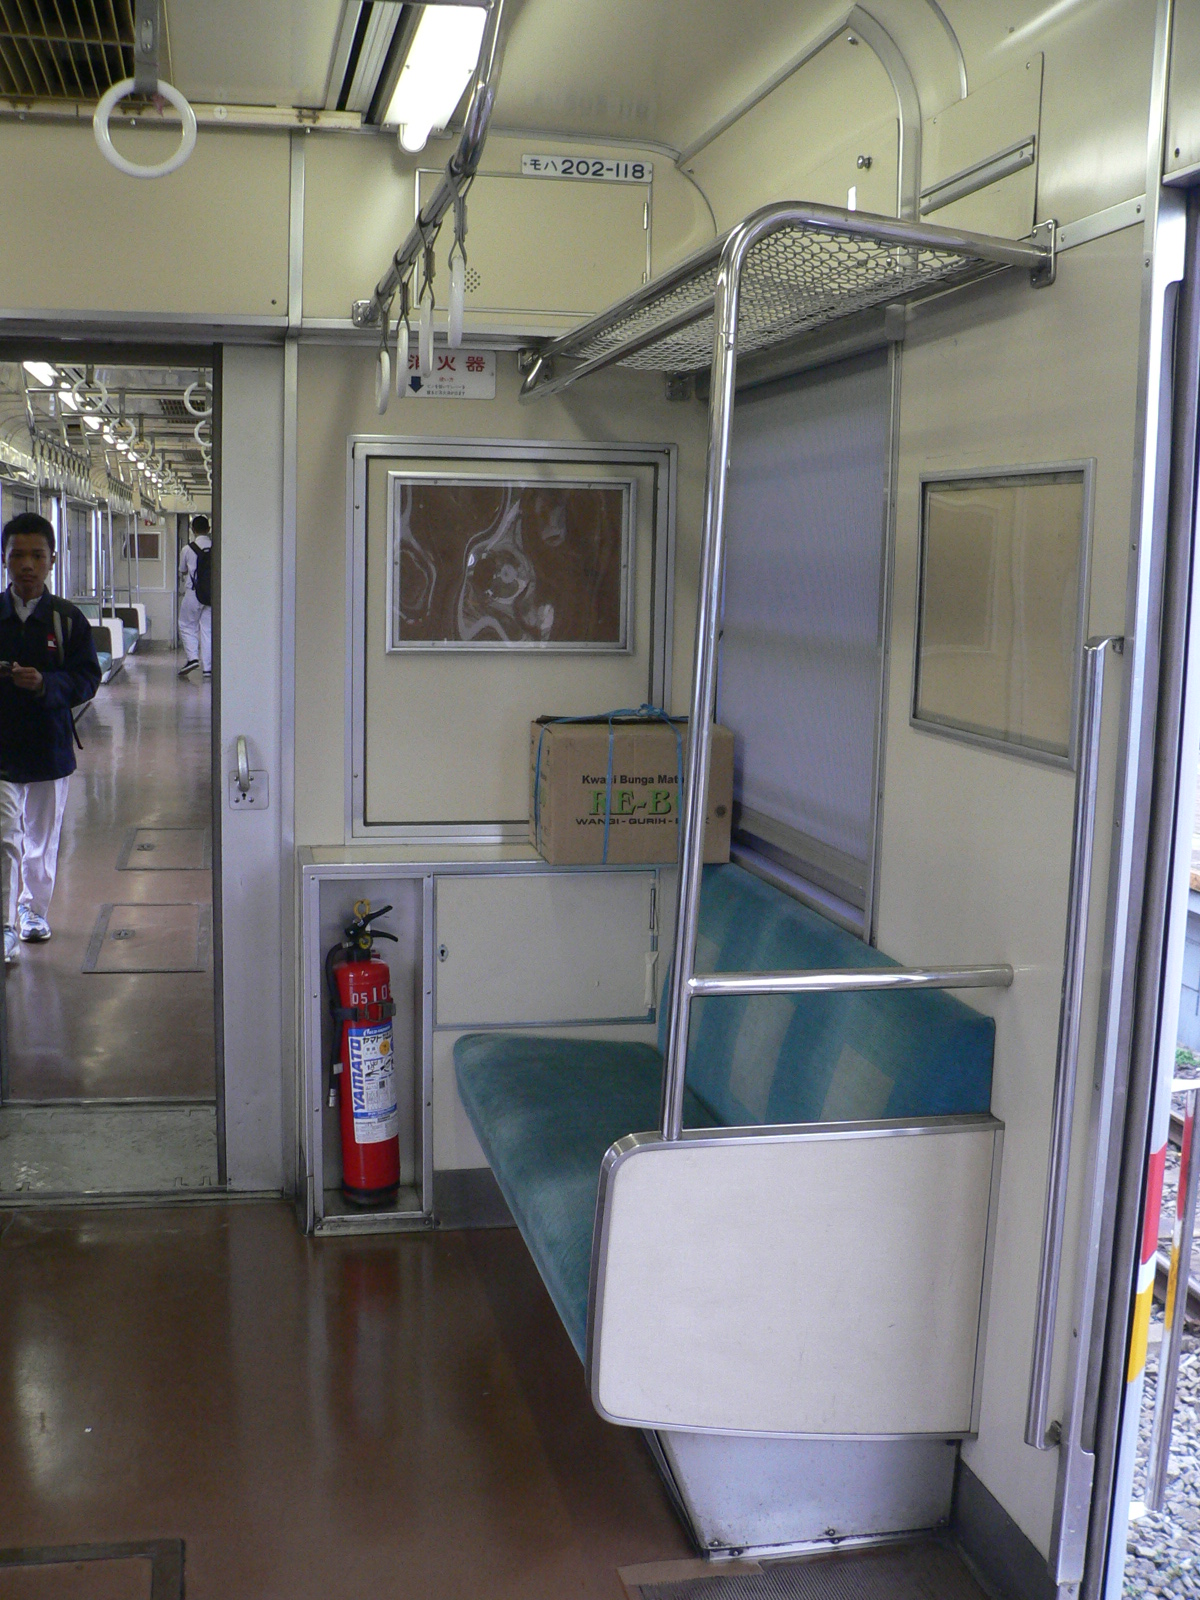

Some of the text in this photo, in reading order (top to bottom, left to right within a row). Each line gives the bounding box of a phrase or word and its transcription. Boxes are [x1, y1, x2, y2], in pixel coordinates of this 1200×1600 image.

[581, 774, 617, 785] Kwai
[619, 775, 655, 786] Bunga
[351, 1038, 366, 1111] YAMATO
